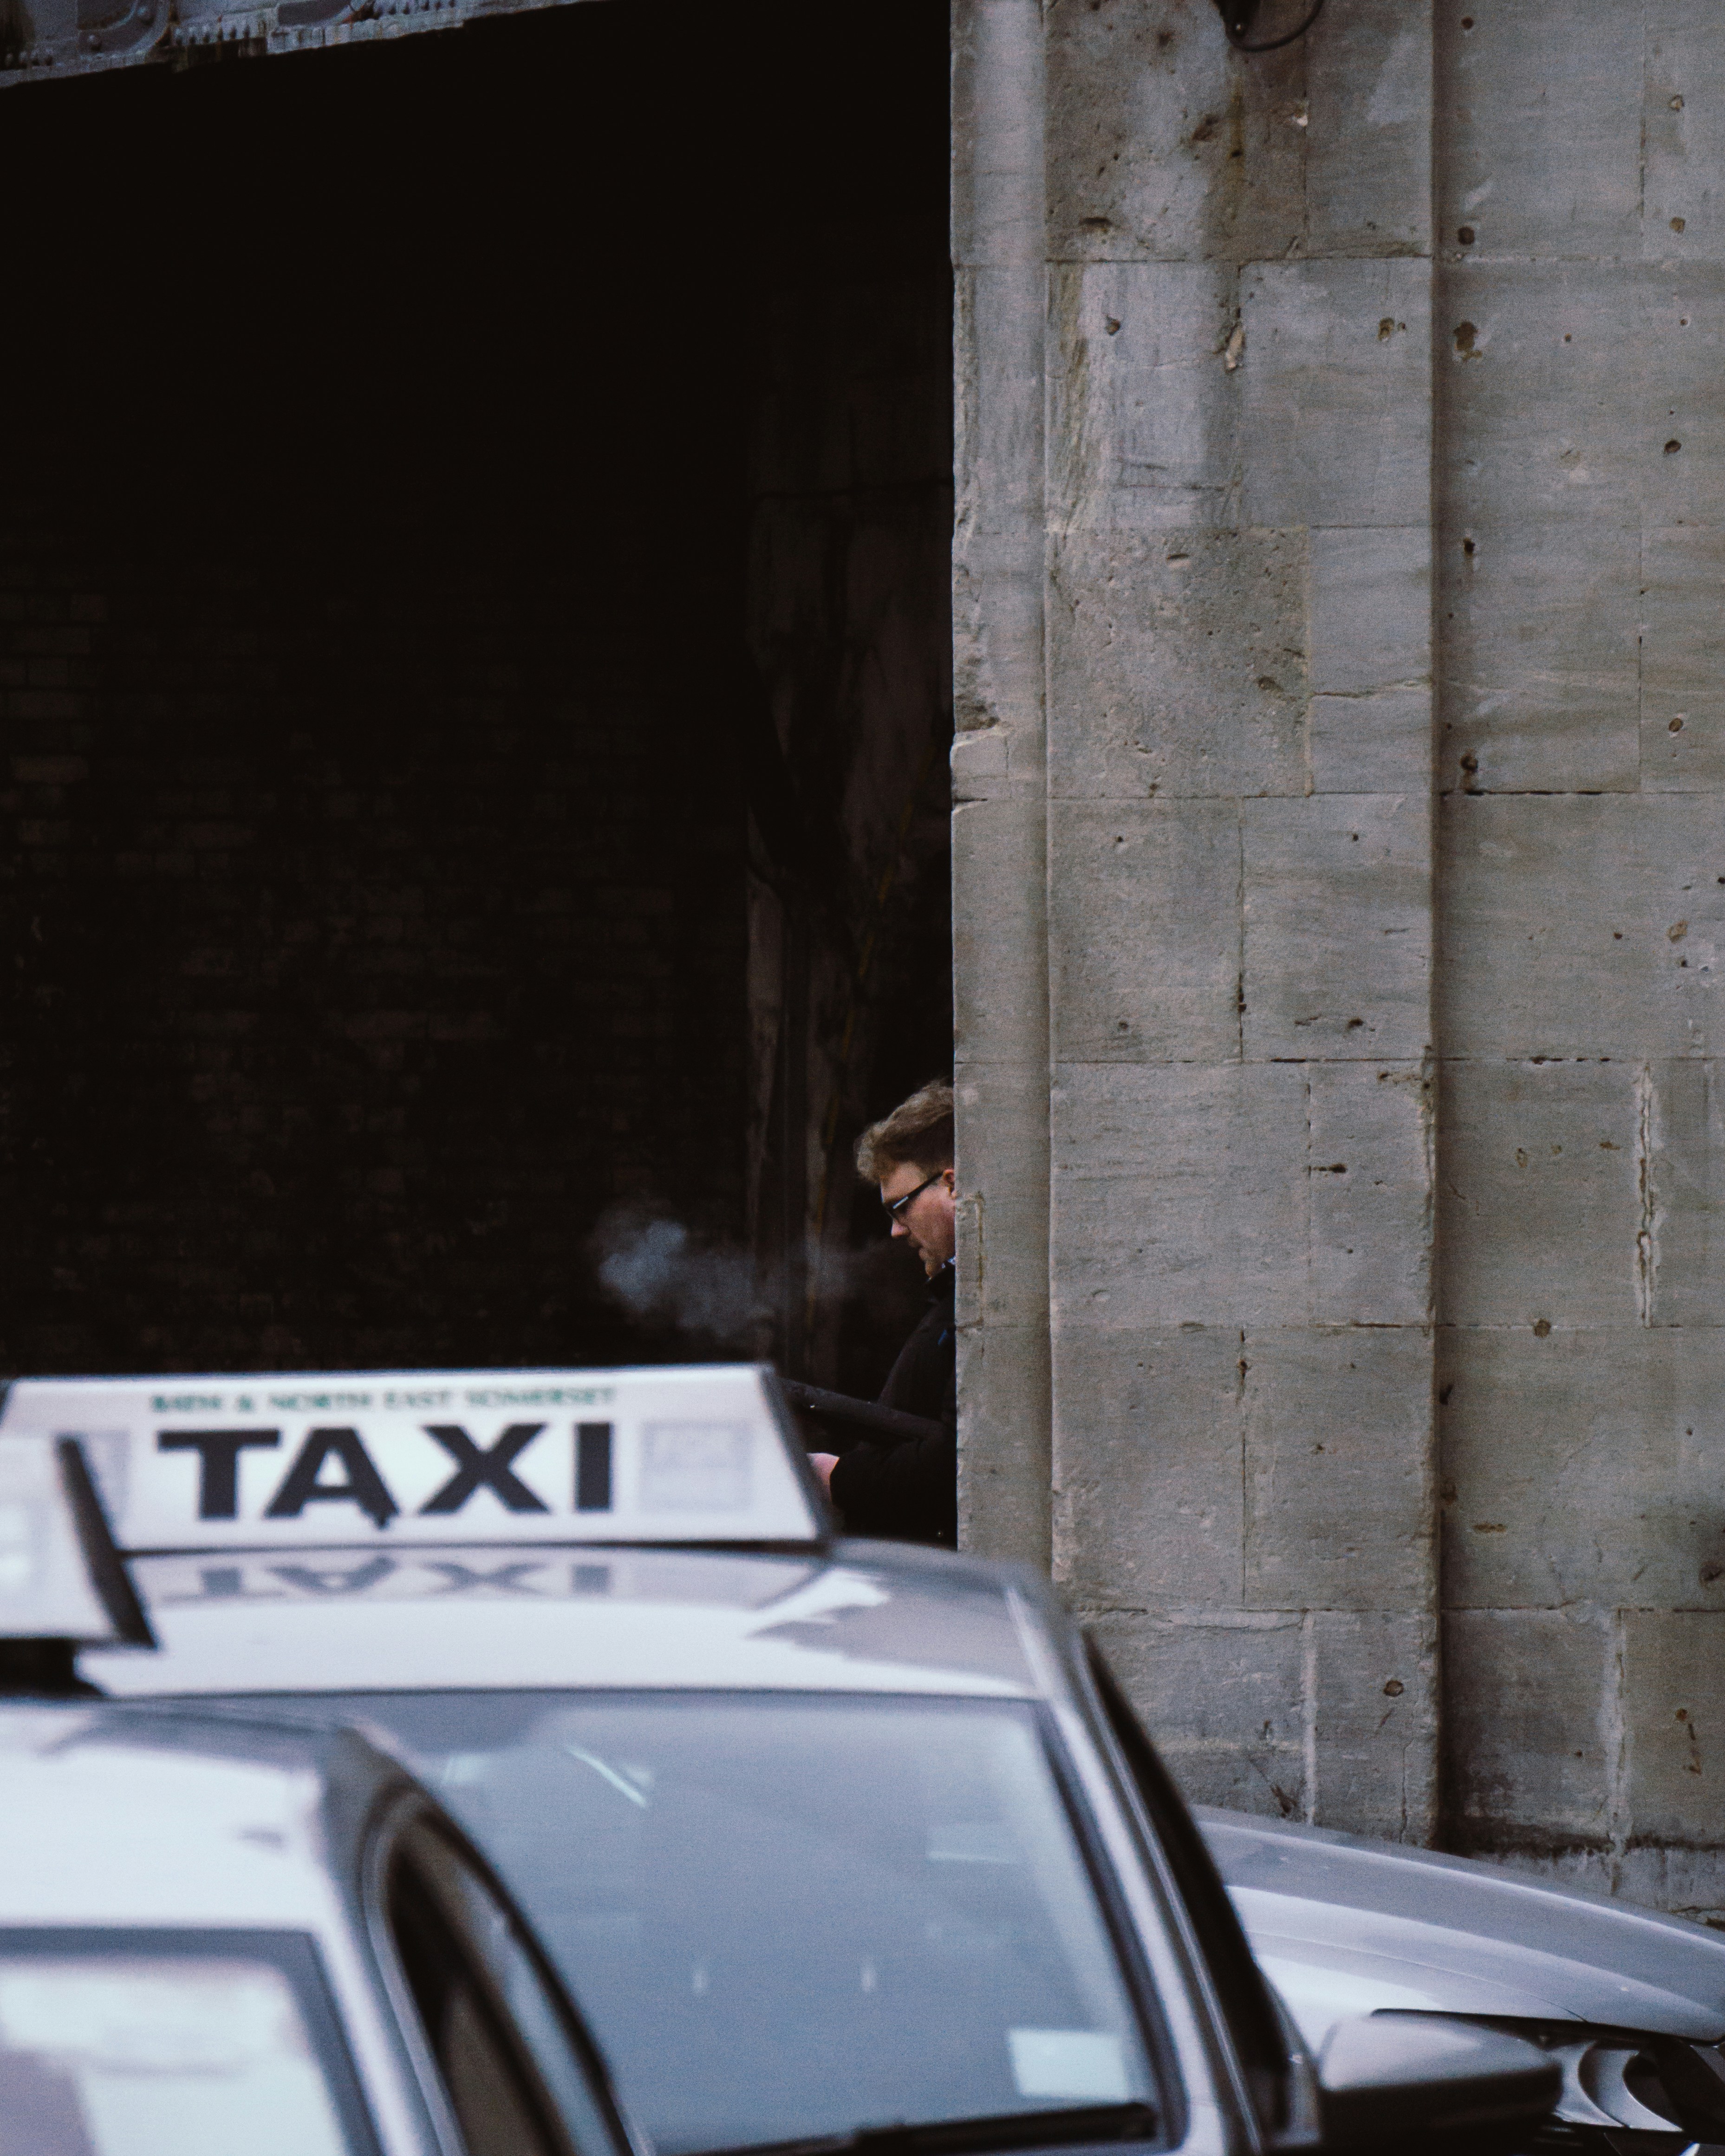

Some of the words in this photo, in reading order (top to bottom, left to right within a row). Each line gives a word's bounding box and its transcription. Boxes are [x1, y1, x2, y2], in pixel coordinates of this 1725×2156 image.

[150, 1394, 223, 1414] BATH
[236, 1393, 257, 1414] &
[270, 1392, 374, 1412] NORTH
[383, 1390, 452, 1410] EAST
[465, 1388, 616, 1409] SOMERSET
[155, 1420, 616, 1525] TAXI
